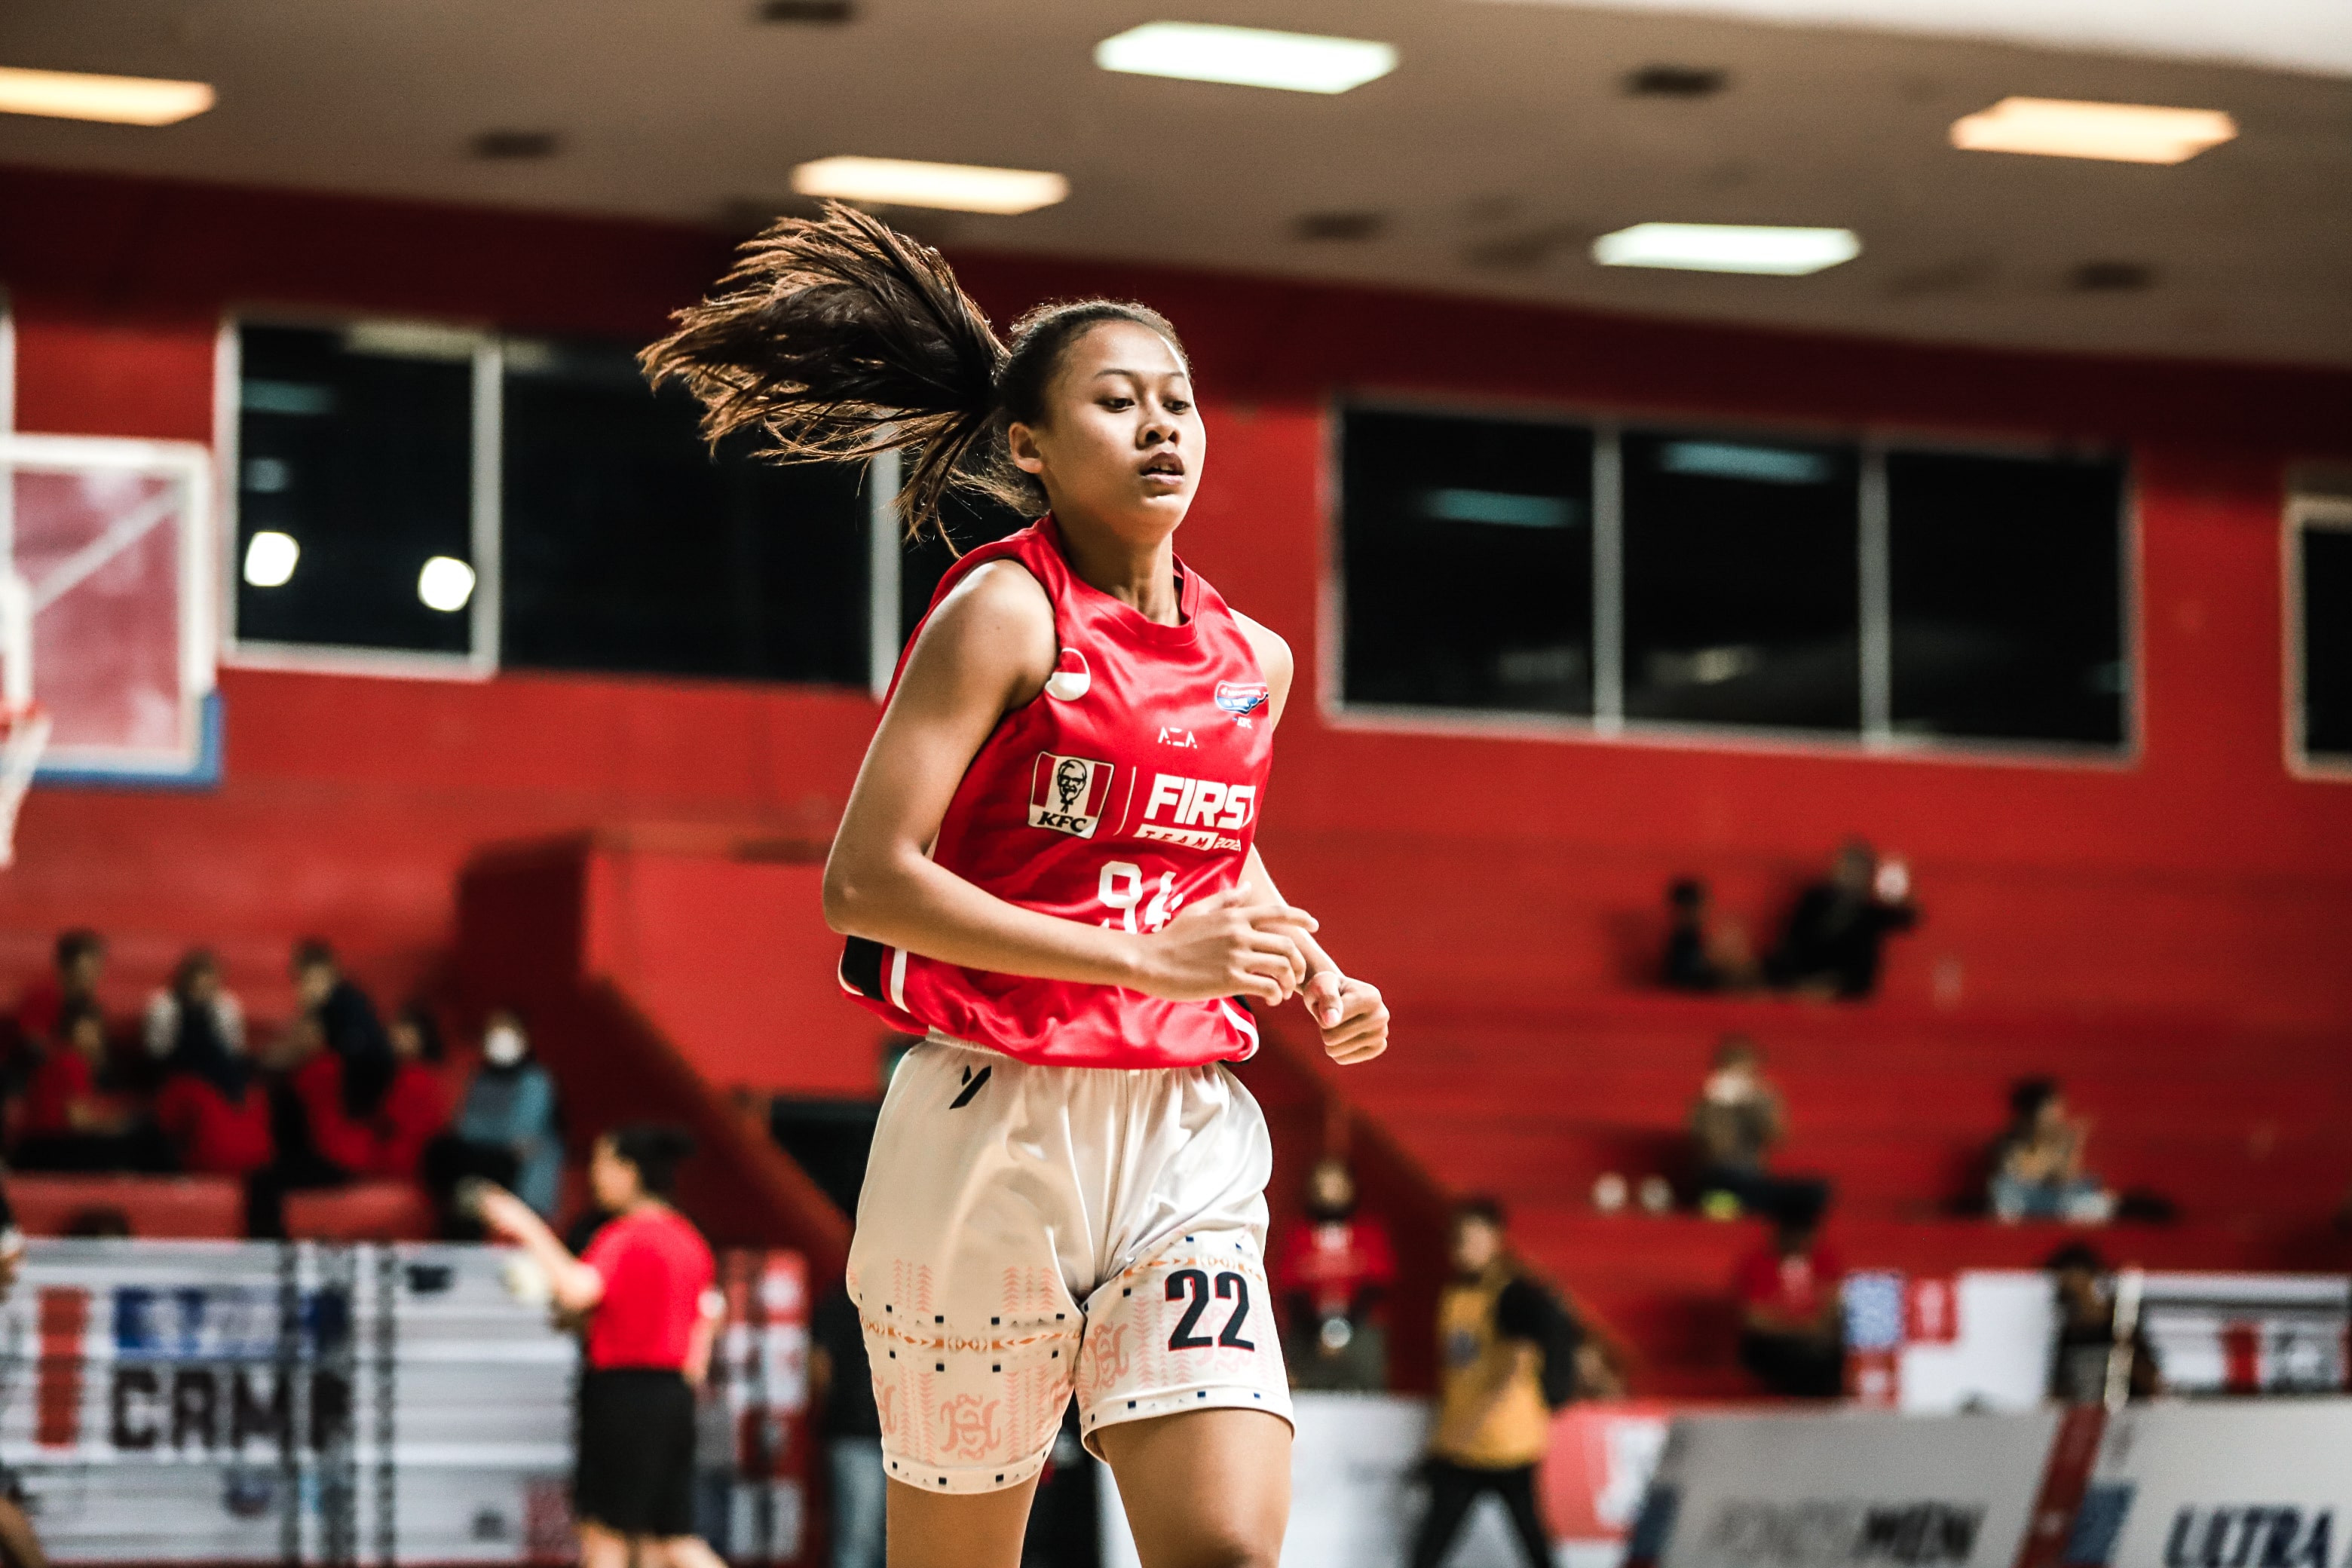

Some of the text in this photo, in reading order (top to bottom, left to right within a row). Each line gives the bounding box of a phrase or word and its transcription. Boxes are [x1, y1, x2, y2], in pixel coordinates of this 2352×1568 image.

[1037, 810, 1088, 833] KFC
[1144, 830, 1208, 849] TEAM
[1164, 1269, 1255, 1353] 22
